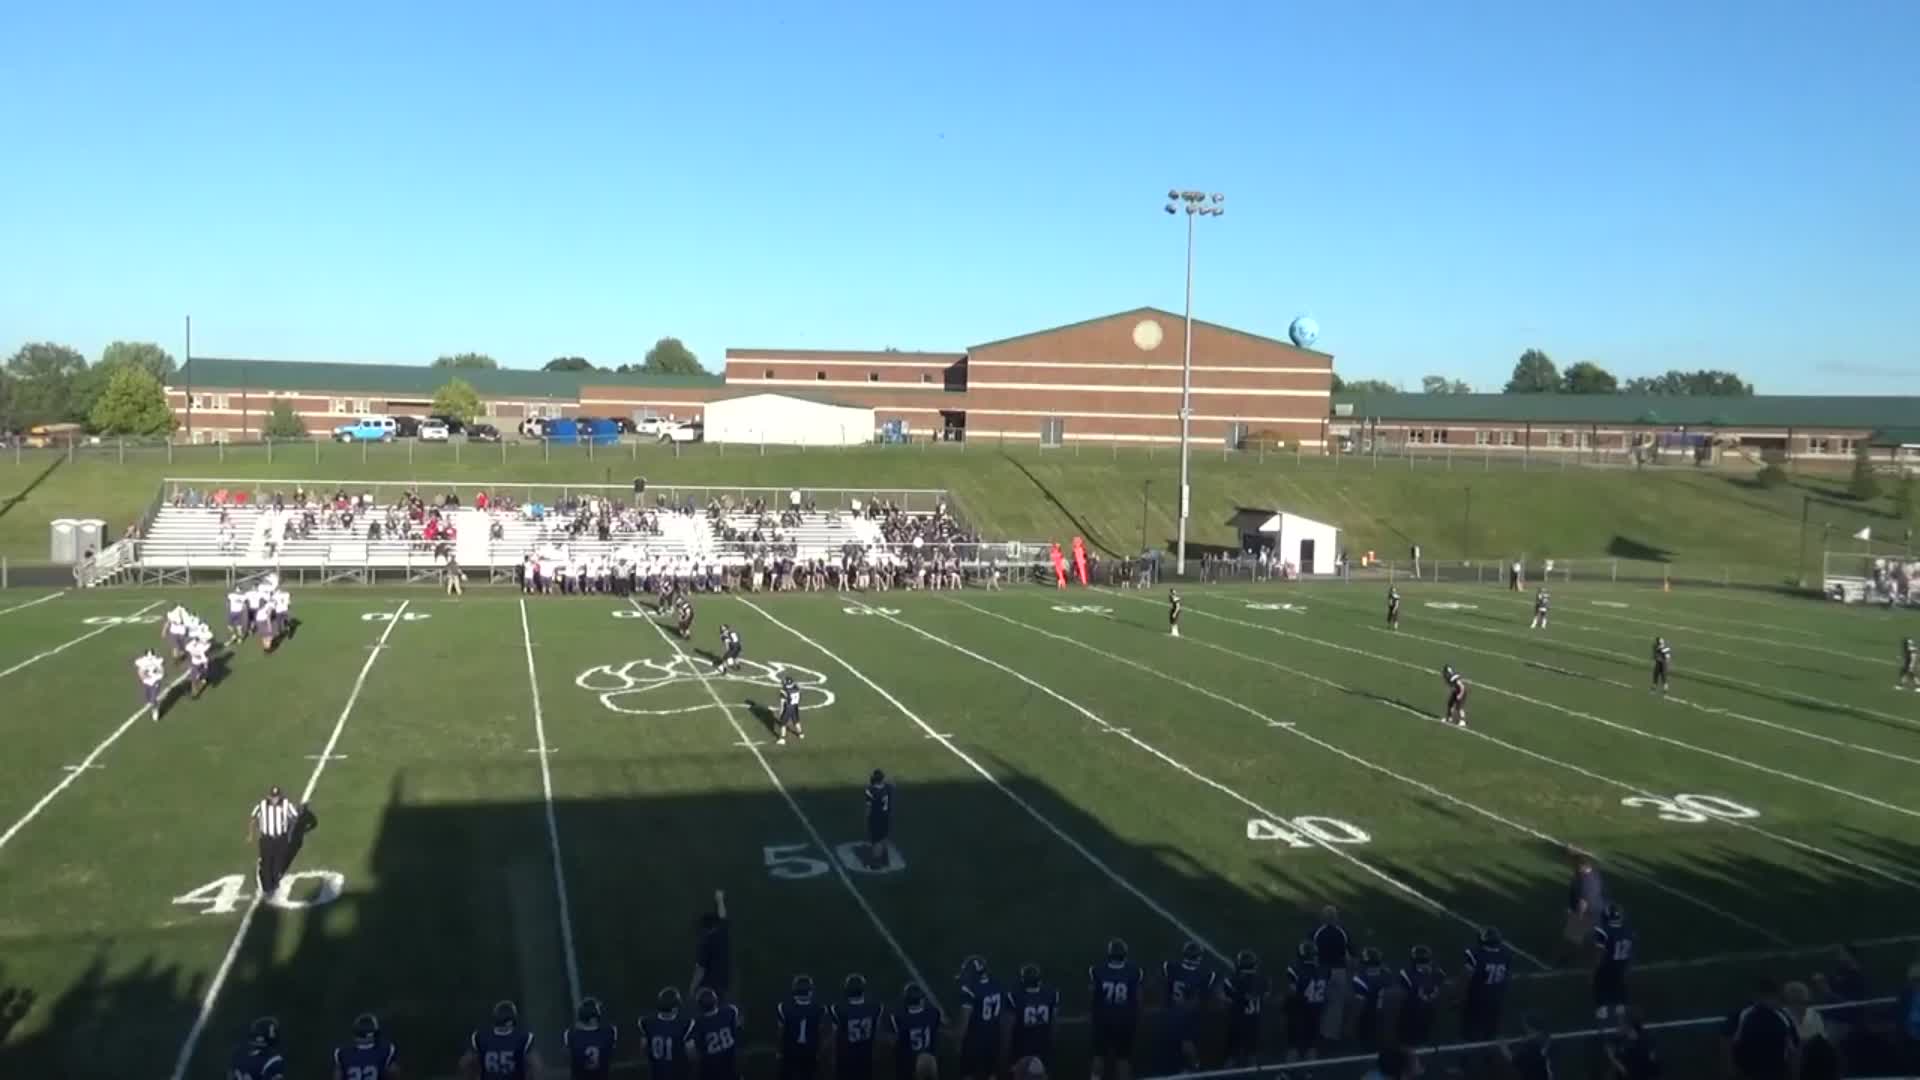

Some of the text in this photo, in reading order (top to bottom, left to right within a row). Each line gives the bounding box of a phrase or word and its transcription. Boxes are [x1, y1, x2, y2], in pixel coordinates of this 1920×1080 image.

[1620, 793, 1761, 822] 30
[1247, 816, 1371, 848] 40
[763, 840, 906, 878] 50
[172, 870, 345, 914] 40
[796, 1018, 808, 1044] 1
[909, 1026, 931, 1051] 51
[583, 1045, 600, 1072] 3
